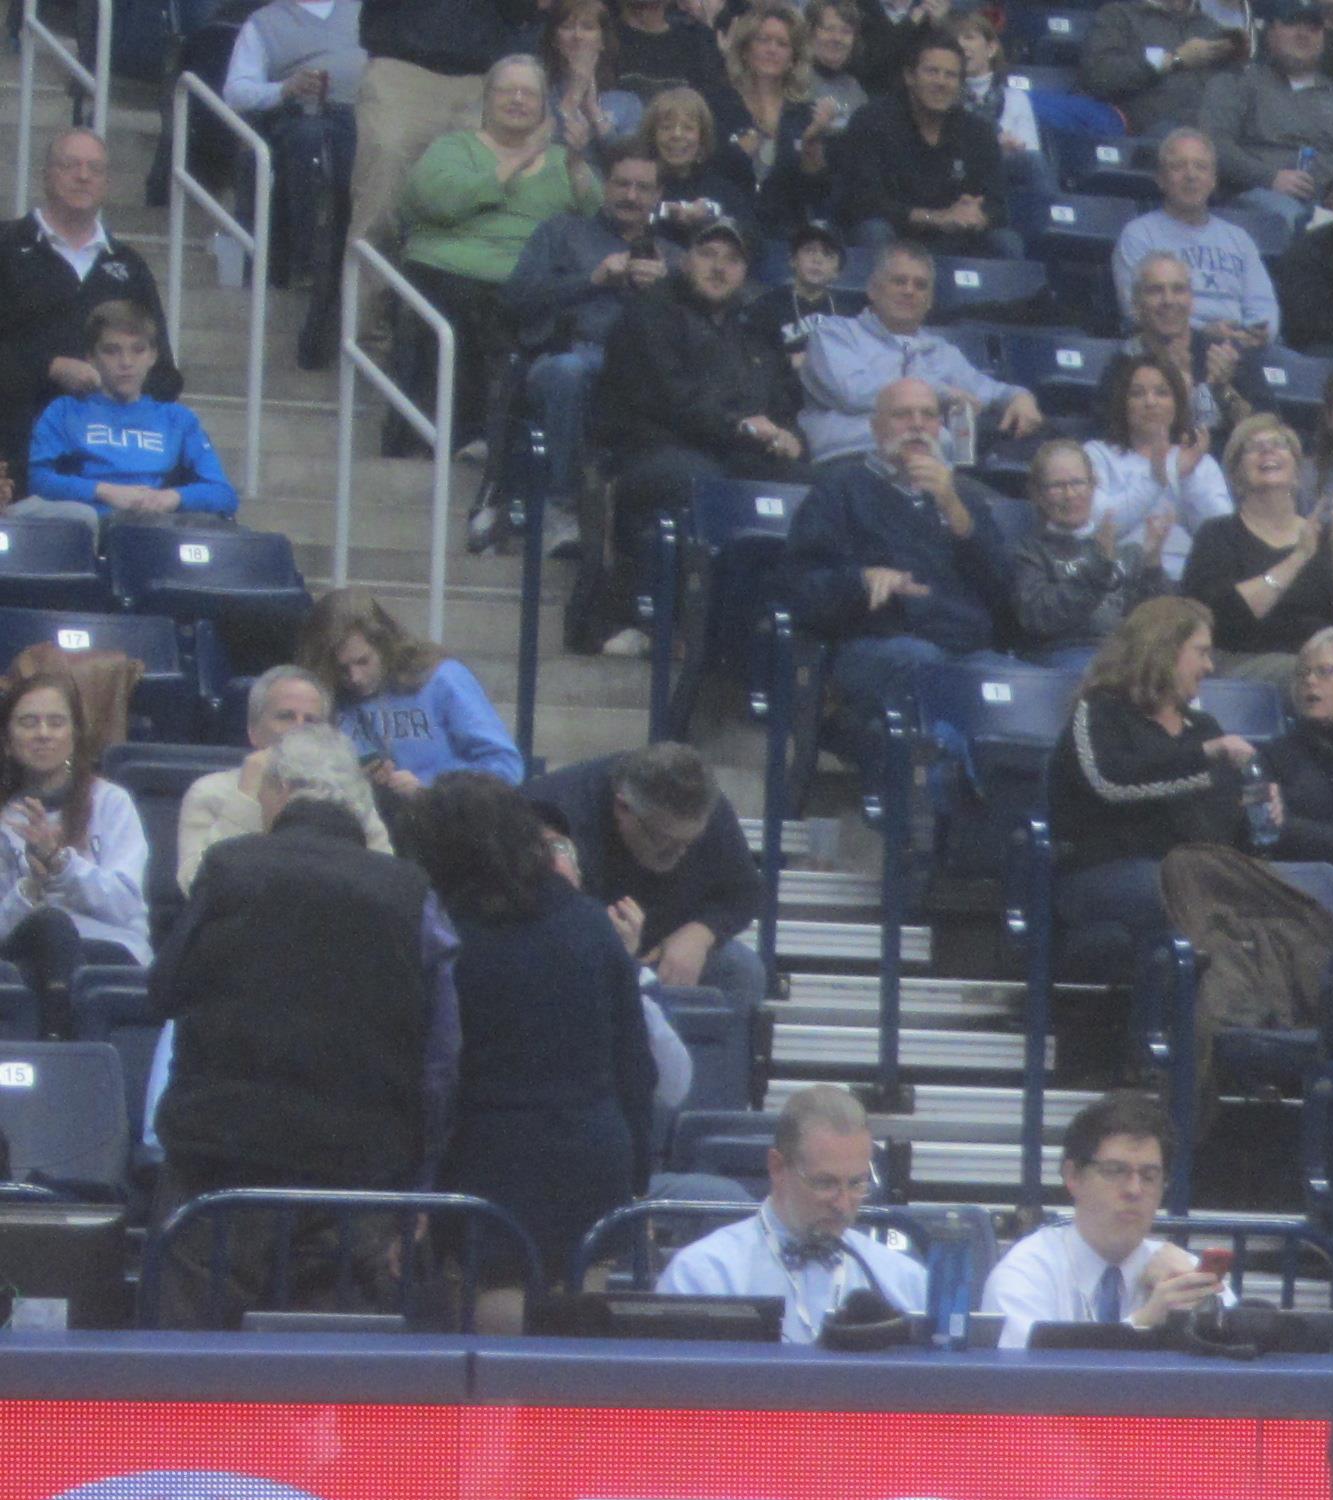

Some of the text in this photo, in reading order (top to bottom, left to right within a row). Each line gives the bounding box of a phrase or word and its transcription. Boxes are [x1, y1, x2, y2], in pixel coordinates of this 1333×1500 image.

[1180, 245, 1245, 273] AVIER
[86, 423, 165, 453] ELITE
[350, 708, 432, 743] AVIER
